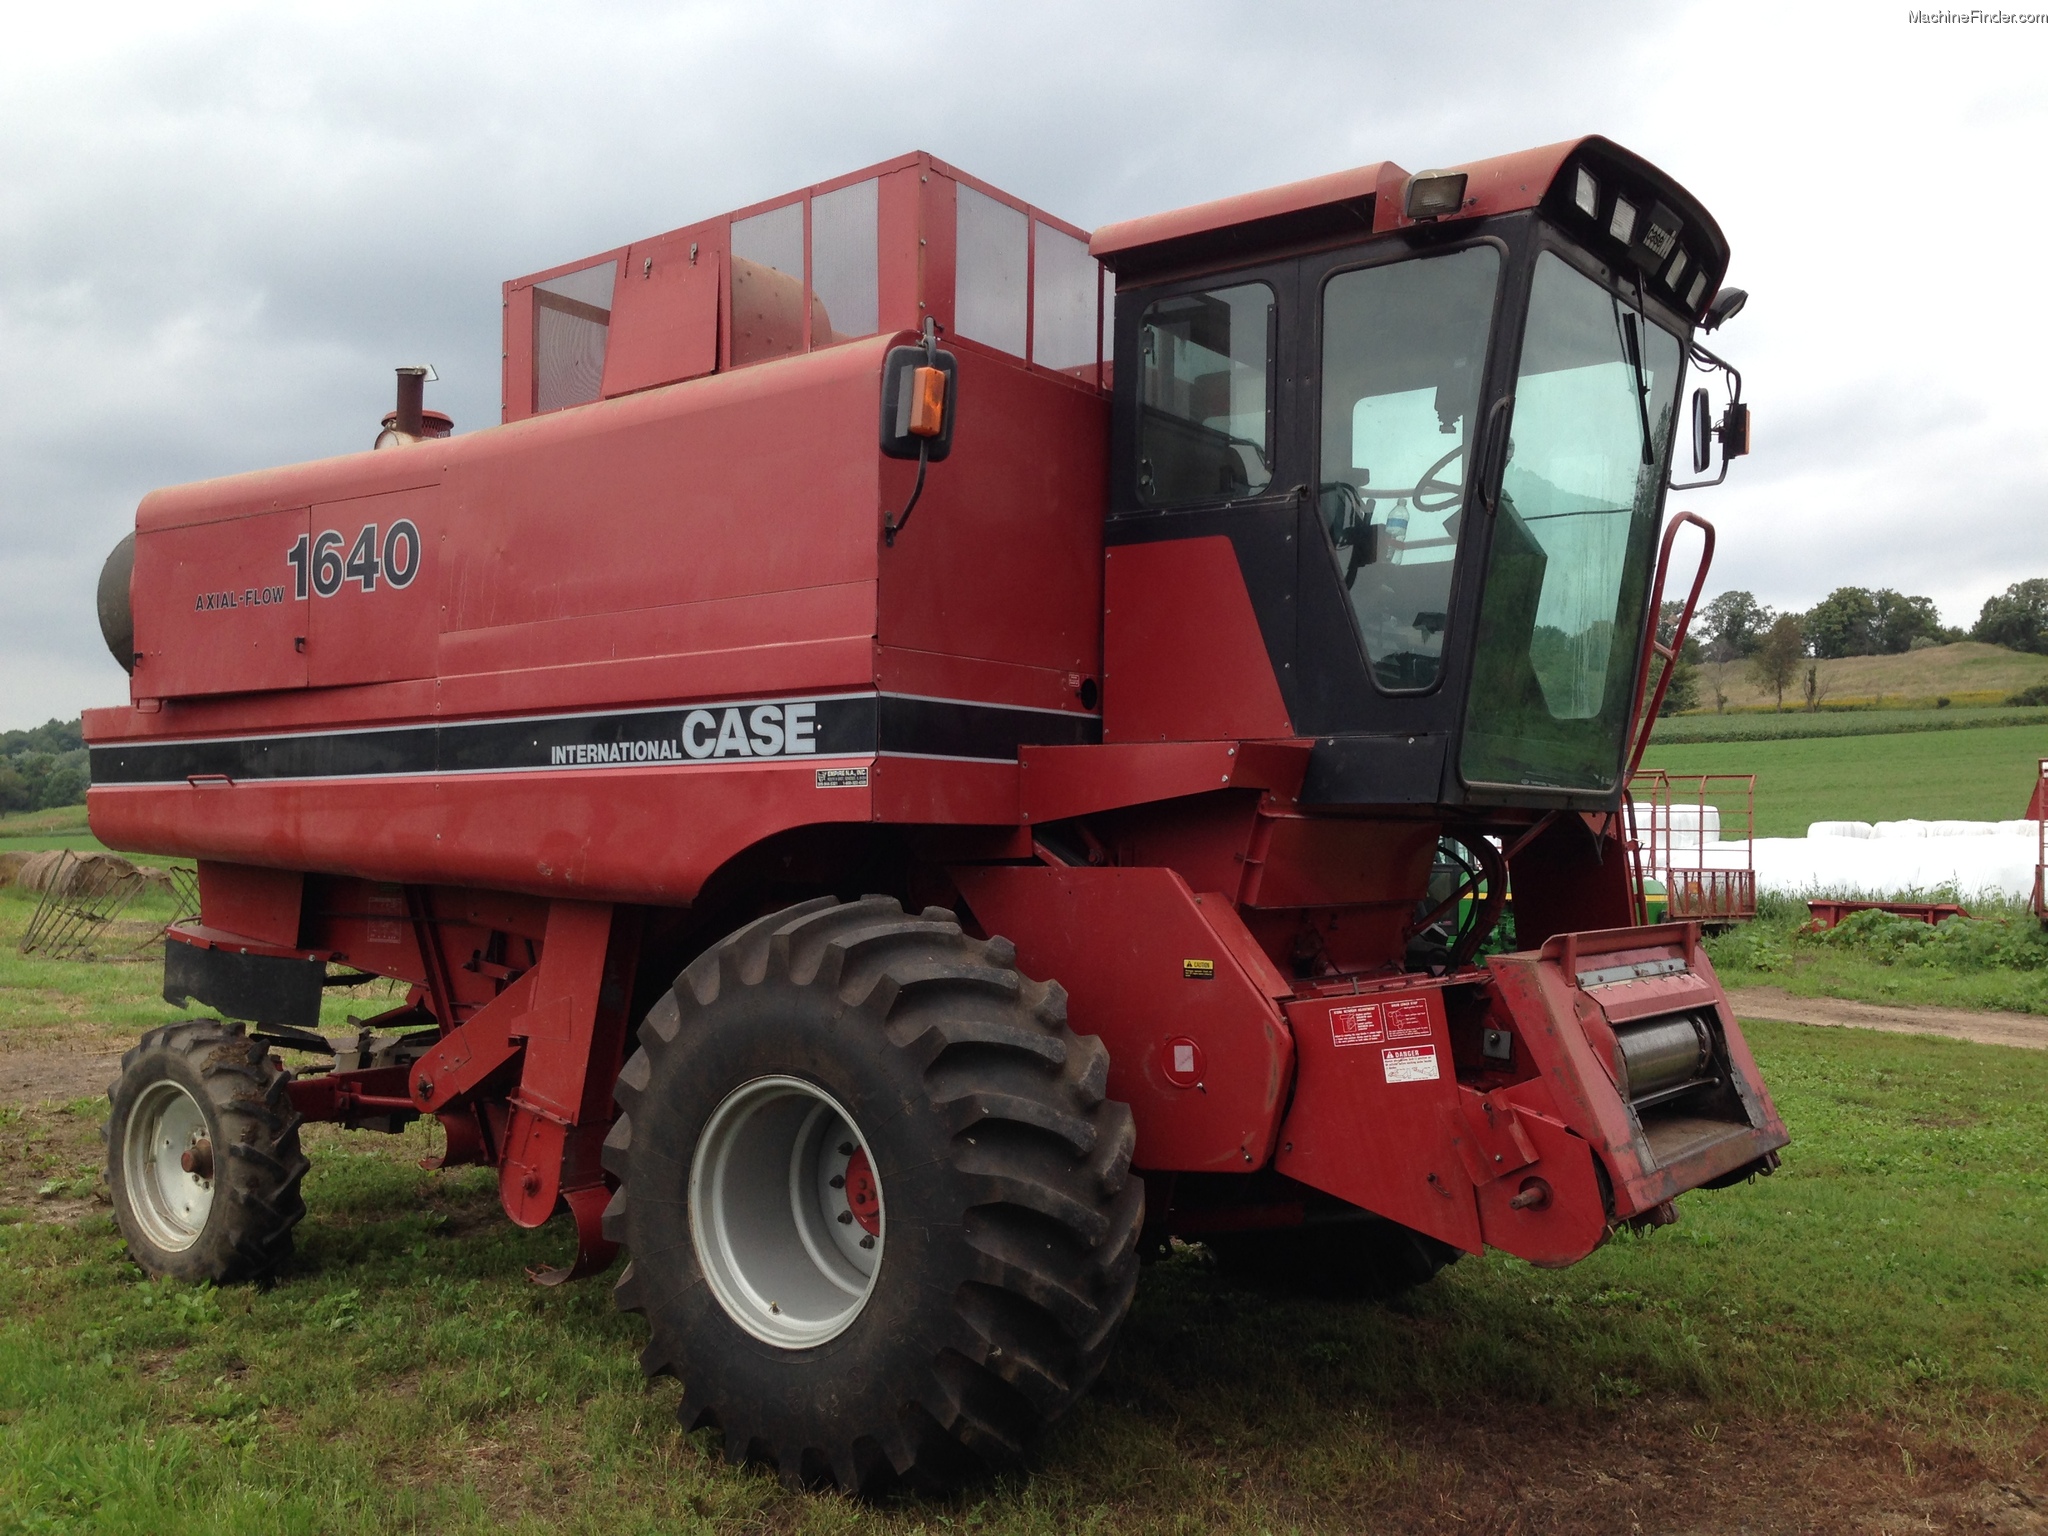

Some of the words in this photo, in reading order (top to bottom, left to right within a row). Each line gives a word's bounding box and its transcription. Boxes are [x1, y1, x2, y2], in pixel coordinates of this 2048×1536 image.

[195, 586, 285, 612] AXIAL-FLOW
[287, 518, 421, 601] 1640
[551, 739, 682, 765] INTERNATIONAL
[681, 702, 816, 759] CASE
[1394, 1049, 1420, 1059] DANGER
